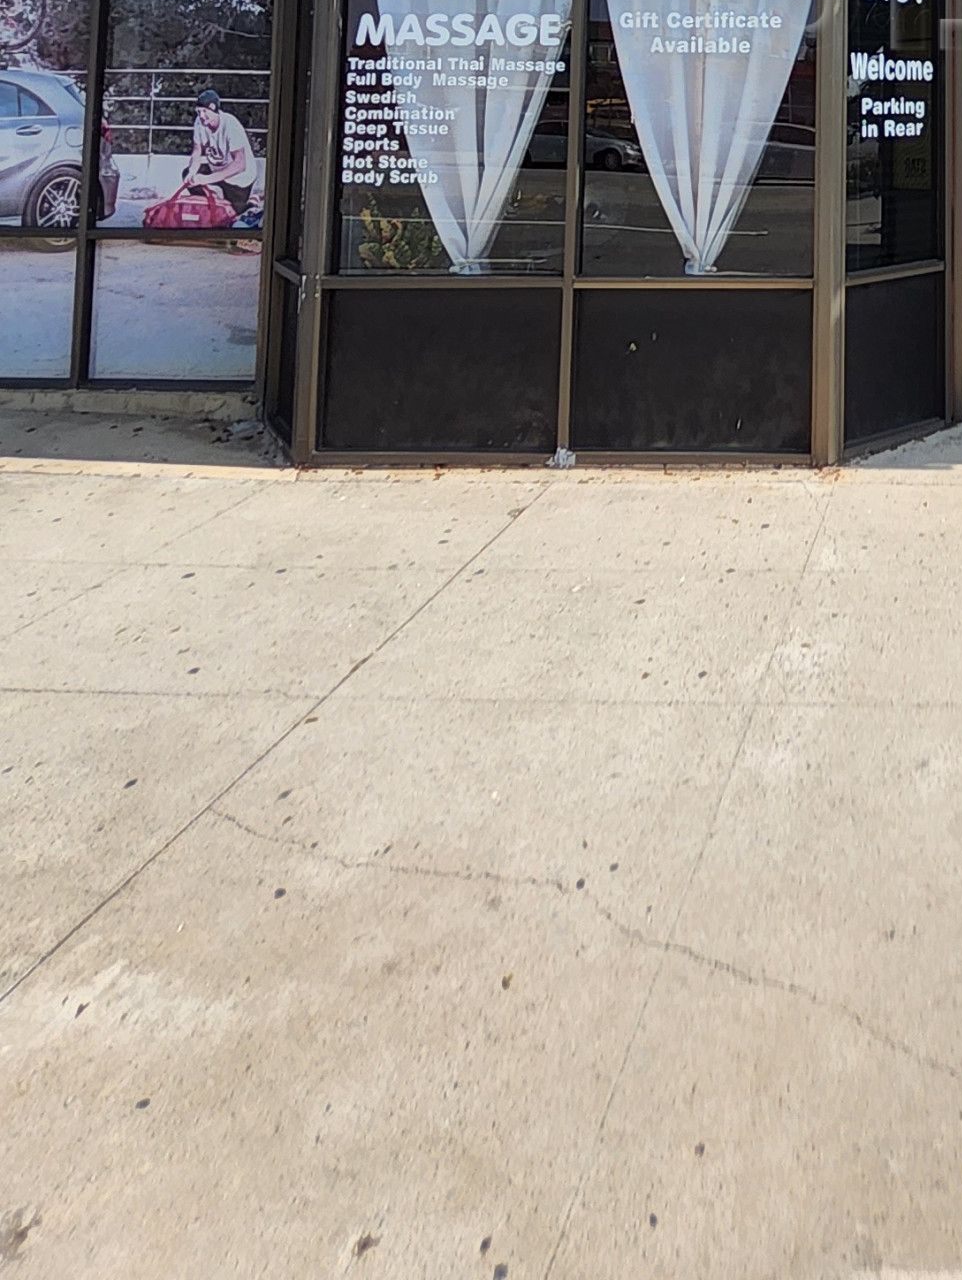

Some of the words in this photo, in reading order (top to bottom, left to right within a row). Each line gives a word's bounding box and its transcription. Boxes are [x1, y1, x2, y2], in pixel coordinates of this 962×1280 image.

[619, 11, 659, 29] Gift
[667, 11, 783, 29] Certificate
[355, 12, 562, 47] MASSAGE
[650, 36, 751, 54] Available
[347, 56, 442, 71] Traditional
[447, 56, 485, 71] Thai
[491, 58, 566, 75] Massage
[850, 51, 934, 82] Welcome
[346, 73, 377, 86] Full
[381, 73, 422, 89] Body
[432, 73, 509, 89] Massage
[345, 90, 417, 104] Swedish
[344, 106, 456, 121] Combination
[861, 97, 926, 119] Parking
[344, 121, 388, 137] Deep
[393, 121, 449, 135] Tissue
[861, 119, 878, 138] in
[884, 120, 924, 137] Rear
[343, 137, 400, 153] Sports
[342, 155, 373, 169] Hot
[378, 155, 429, 169] Stone
[341, 170, 385, 187] Body
[389, 170, 439, 184] Scrub
